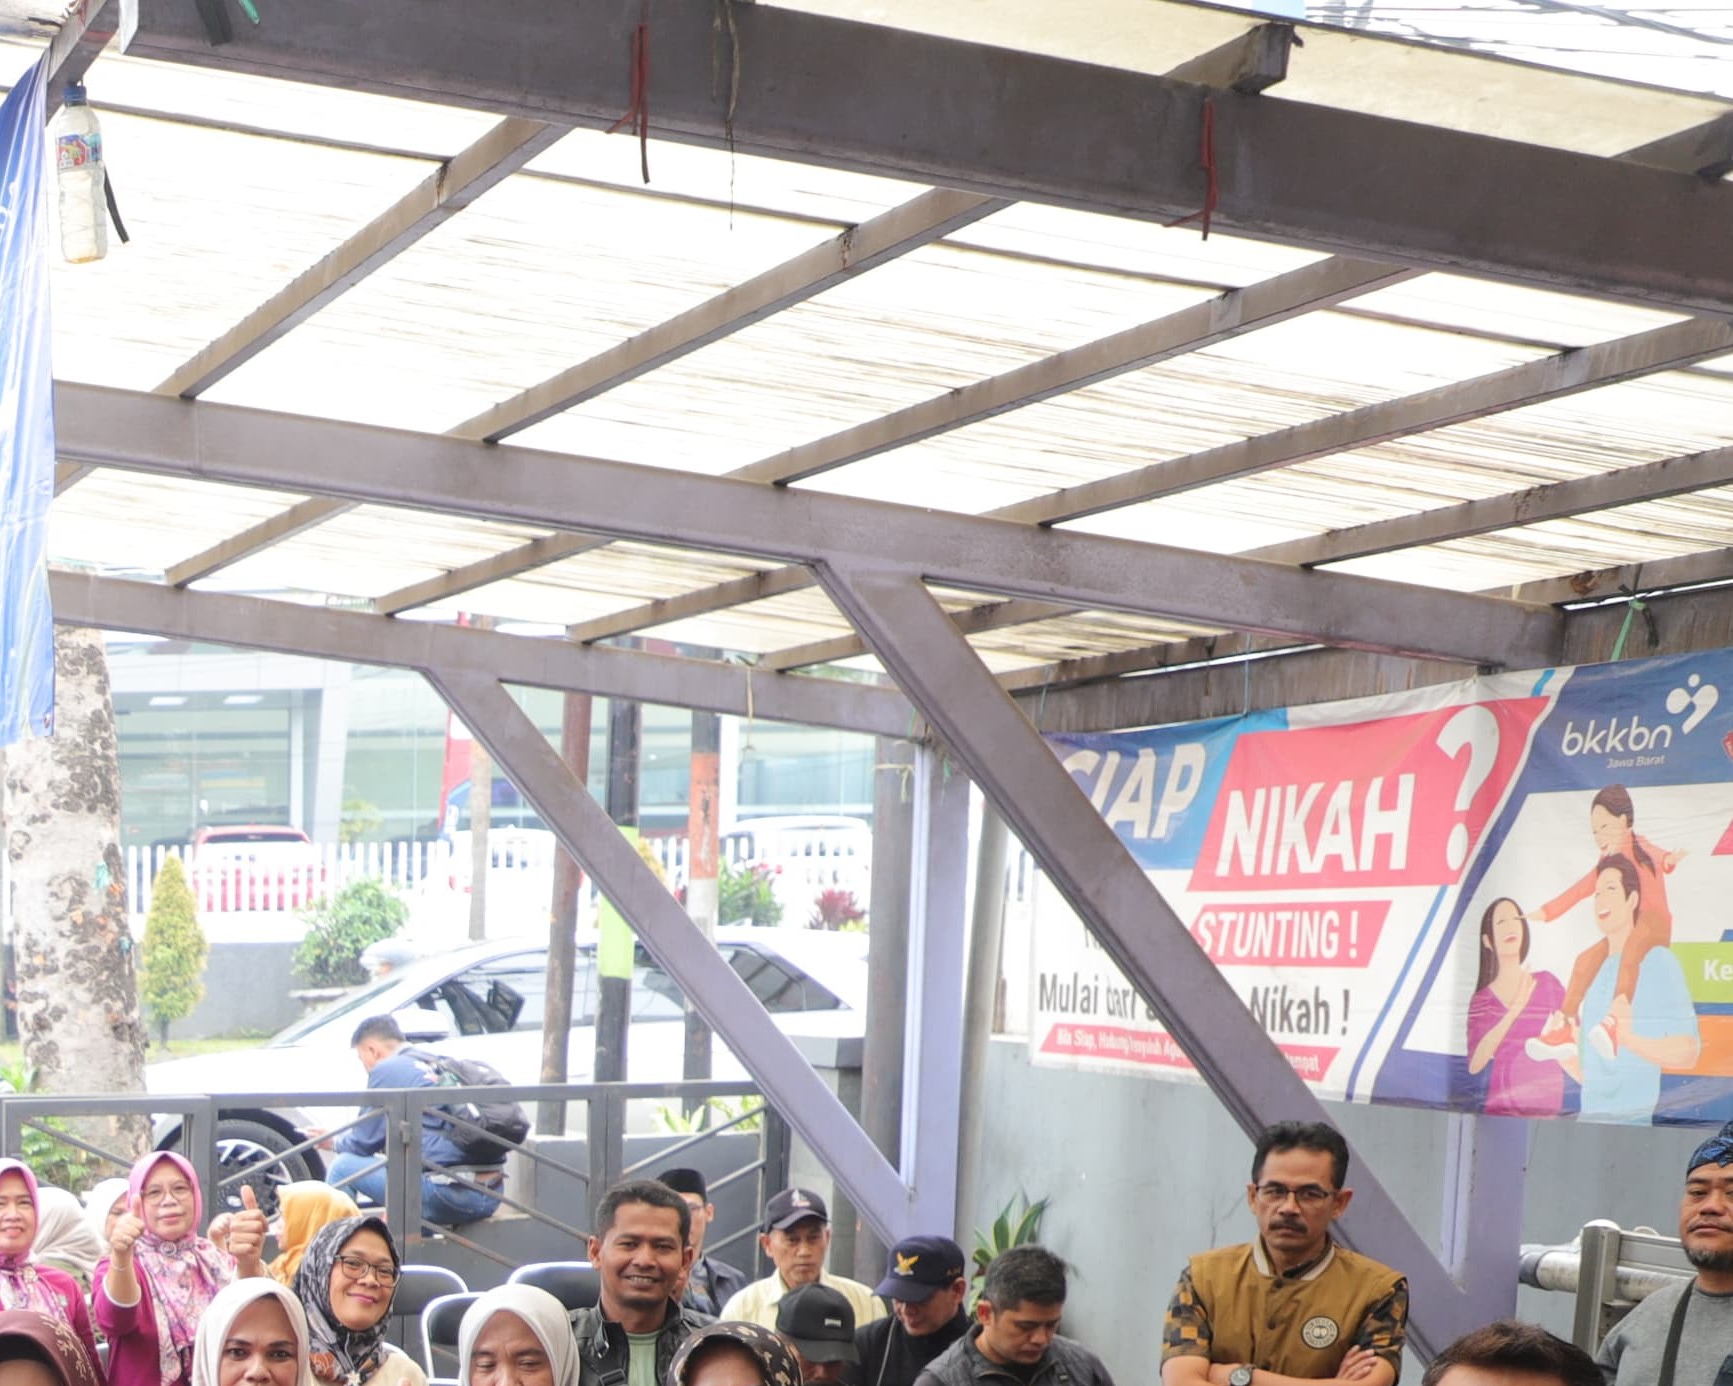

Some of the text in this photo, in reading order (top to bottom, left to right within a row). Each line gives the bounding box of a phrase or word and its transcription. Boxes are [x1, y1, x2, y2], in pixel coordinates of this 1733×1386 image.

[1561, 715, 1673, 757] bkkbn
[1606, 755, 1665, 769] Jawa Barat
[1215, 705, 1501, 879] NIKAH ?
[1197, 911, 1339, 959] STUNTING
[1039, 972, 1098, 1015] Mulai
[1250, 984, 1330, 1035] Nikah
